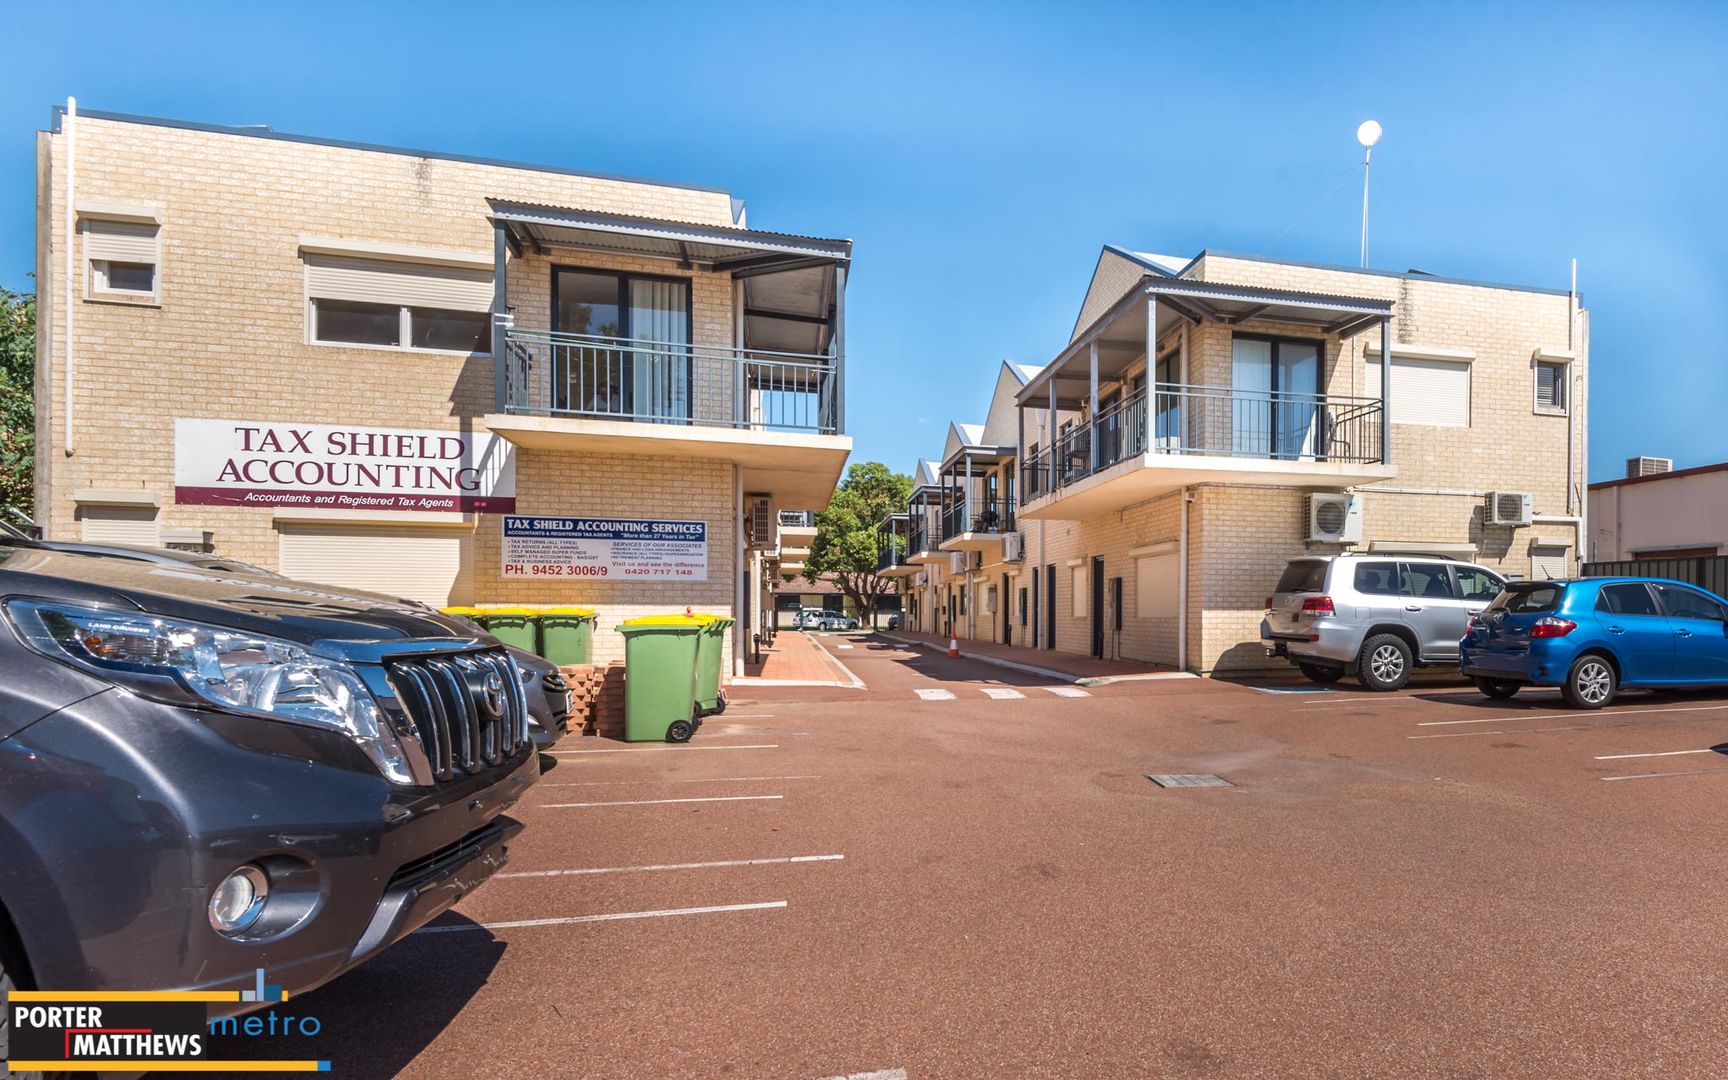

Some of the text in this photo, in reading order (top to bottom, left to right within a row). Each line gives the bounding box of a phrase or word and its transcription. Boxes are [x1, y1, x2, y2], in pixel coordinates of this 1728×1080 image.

[234, 428, 465, 460] TAX SHIELD
[216, 458, 480, 490] ACCOUNTING
[244, 492, 454, 508] Accountants and Registered Tax Agents
[507, 519, 703, 533] TAX SHIELD ACCOUNTING SERVICES
[505, 564, 608, 575] PH. 9452 3006/9
[112, 625, 150, 634] CRUISER
